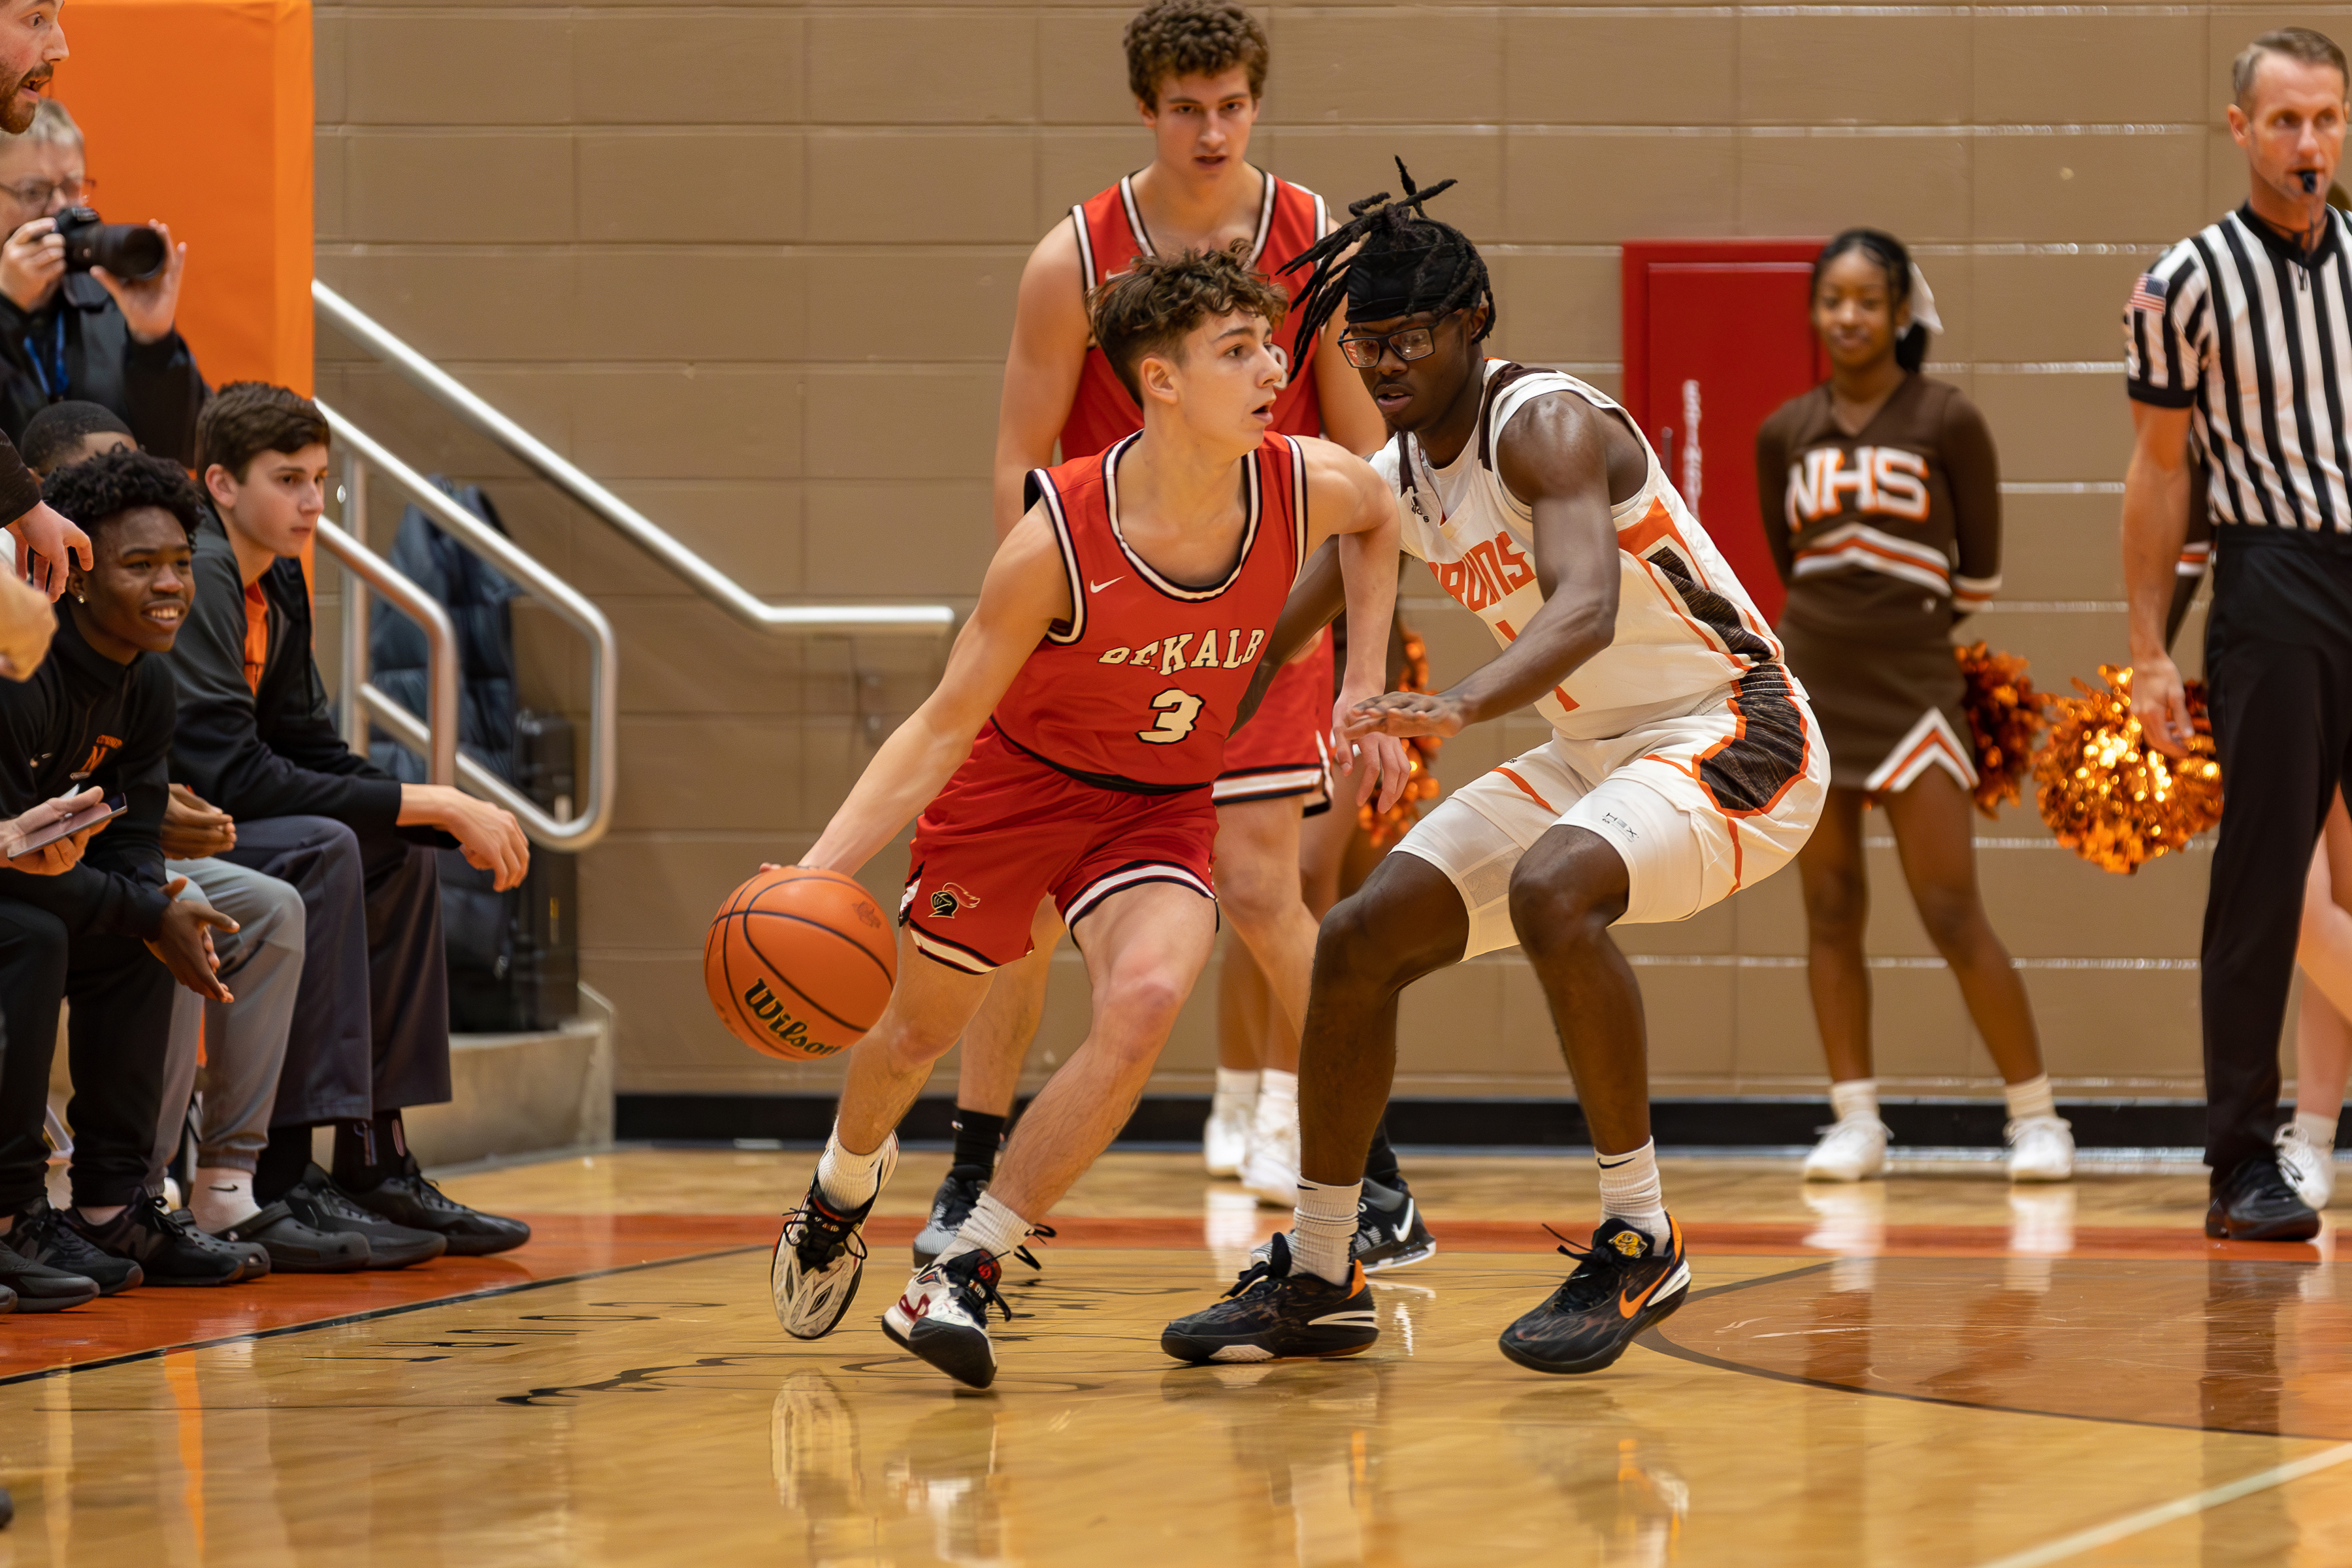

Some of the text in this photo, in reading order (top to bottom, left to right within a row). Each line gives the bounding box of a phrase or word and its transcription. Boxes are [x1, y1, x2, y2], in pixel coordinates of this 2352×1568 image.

[1784, 446, 1931, 532] NHS
[1428, 531, 1537, 613] RUINS
[1097, 628, 1266, 676] DEKALB
[1134, 687, 1206, 745] 3
[744, 977, 843, 1056] Wilson
